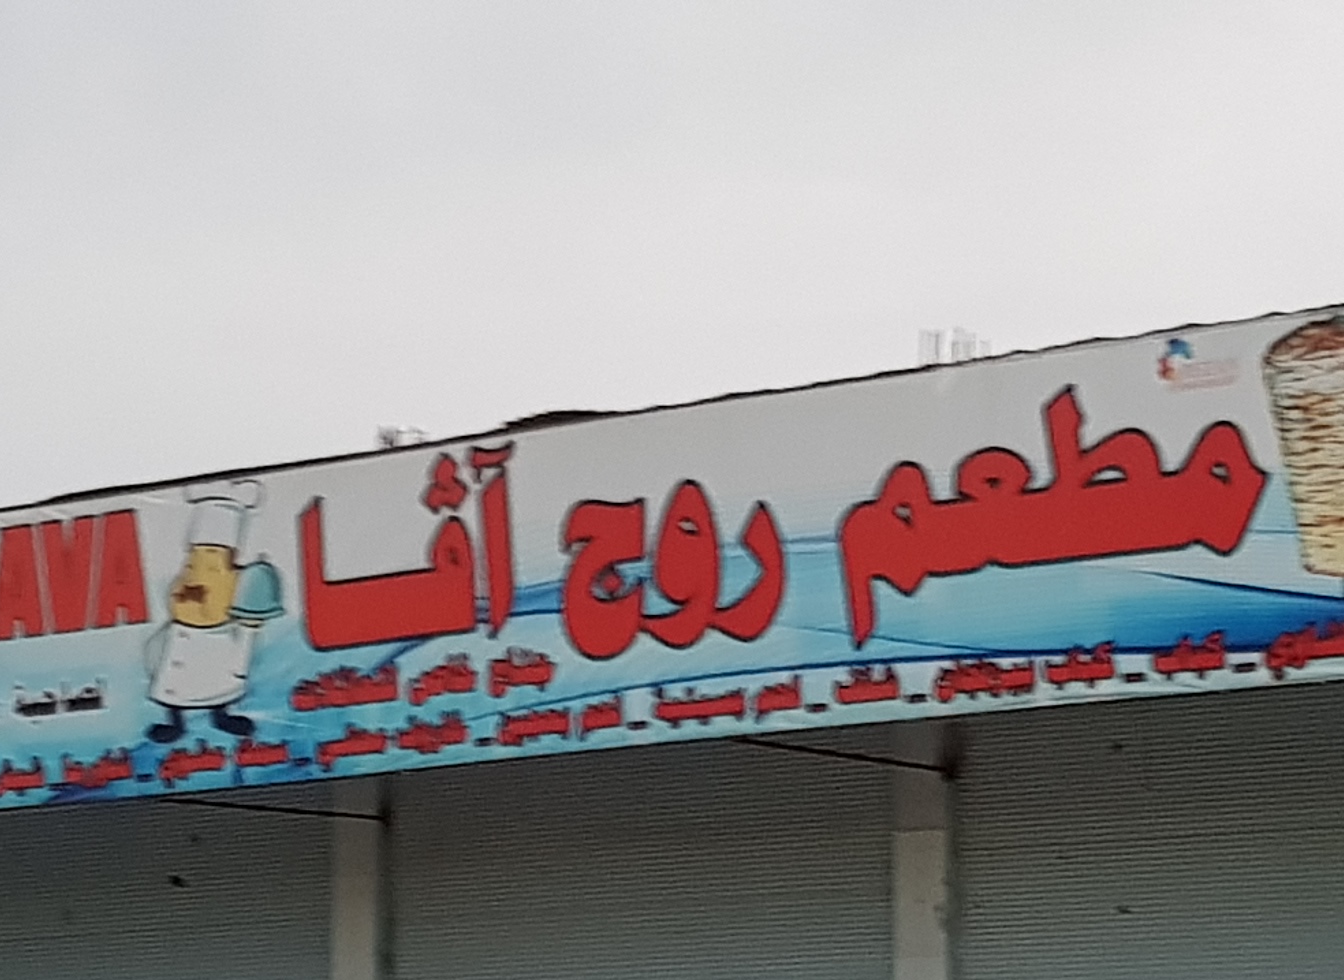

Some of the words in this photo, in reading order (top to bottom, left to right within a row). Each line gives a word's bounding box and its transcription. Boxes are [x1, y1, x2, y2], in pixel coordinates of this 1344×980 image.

[563, 479, 786, 661] روج
[840, 386, 1267, 649] مطعم
[1043, 639, 1116, 690] كباب
[1153, 629, 1227, 681] كباب
